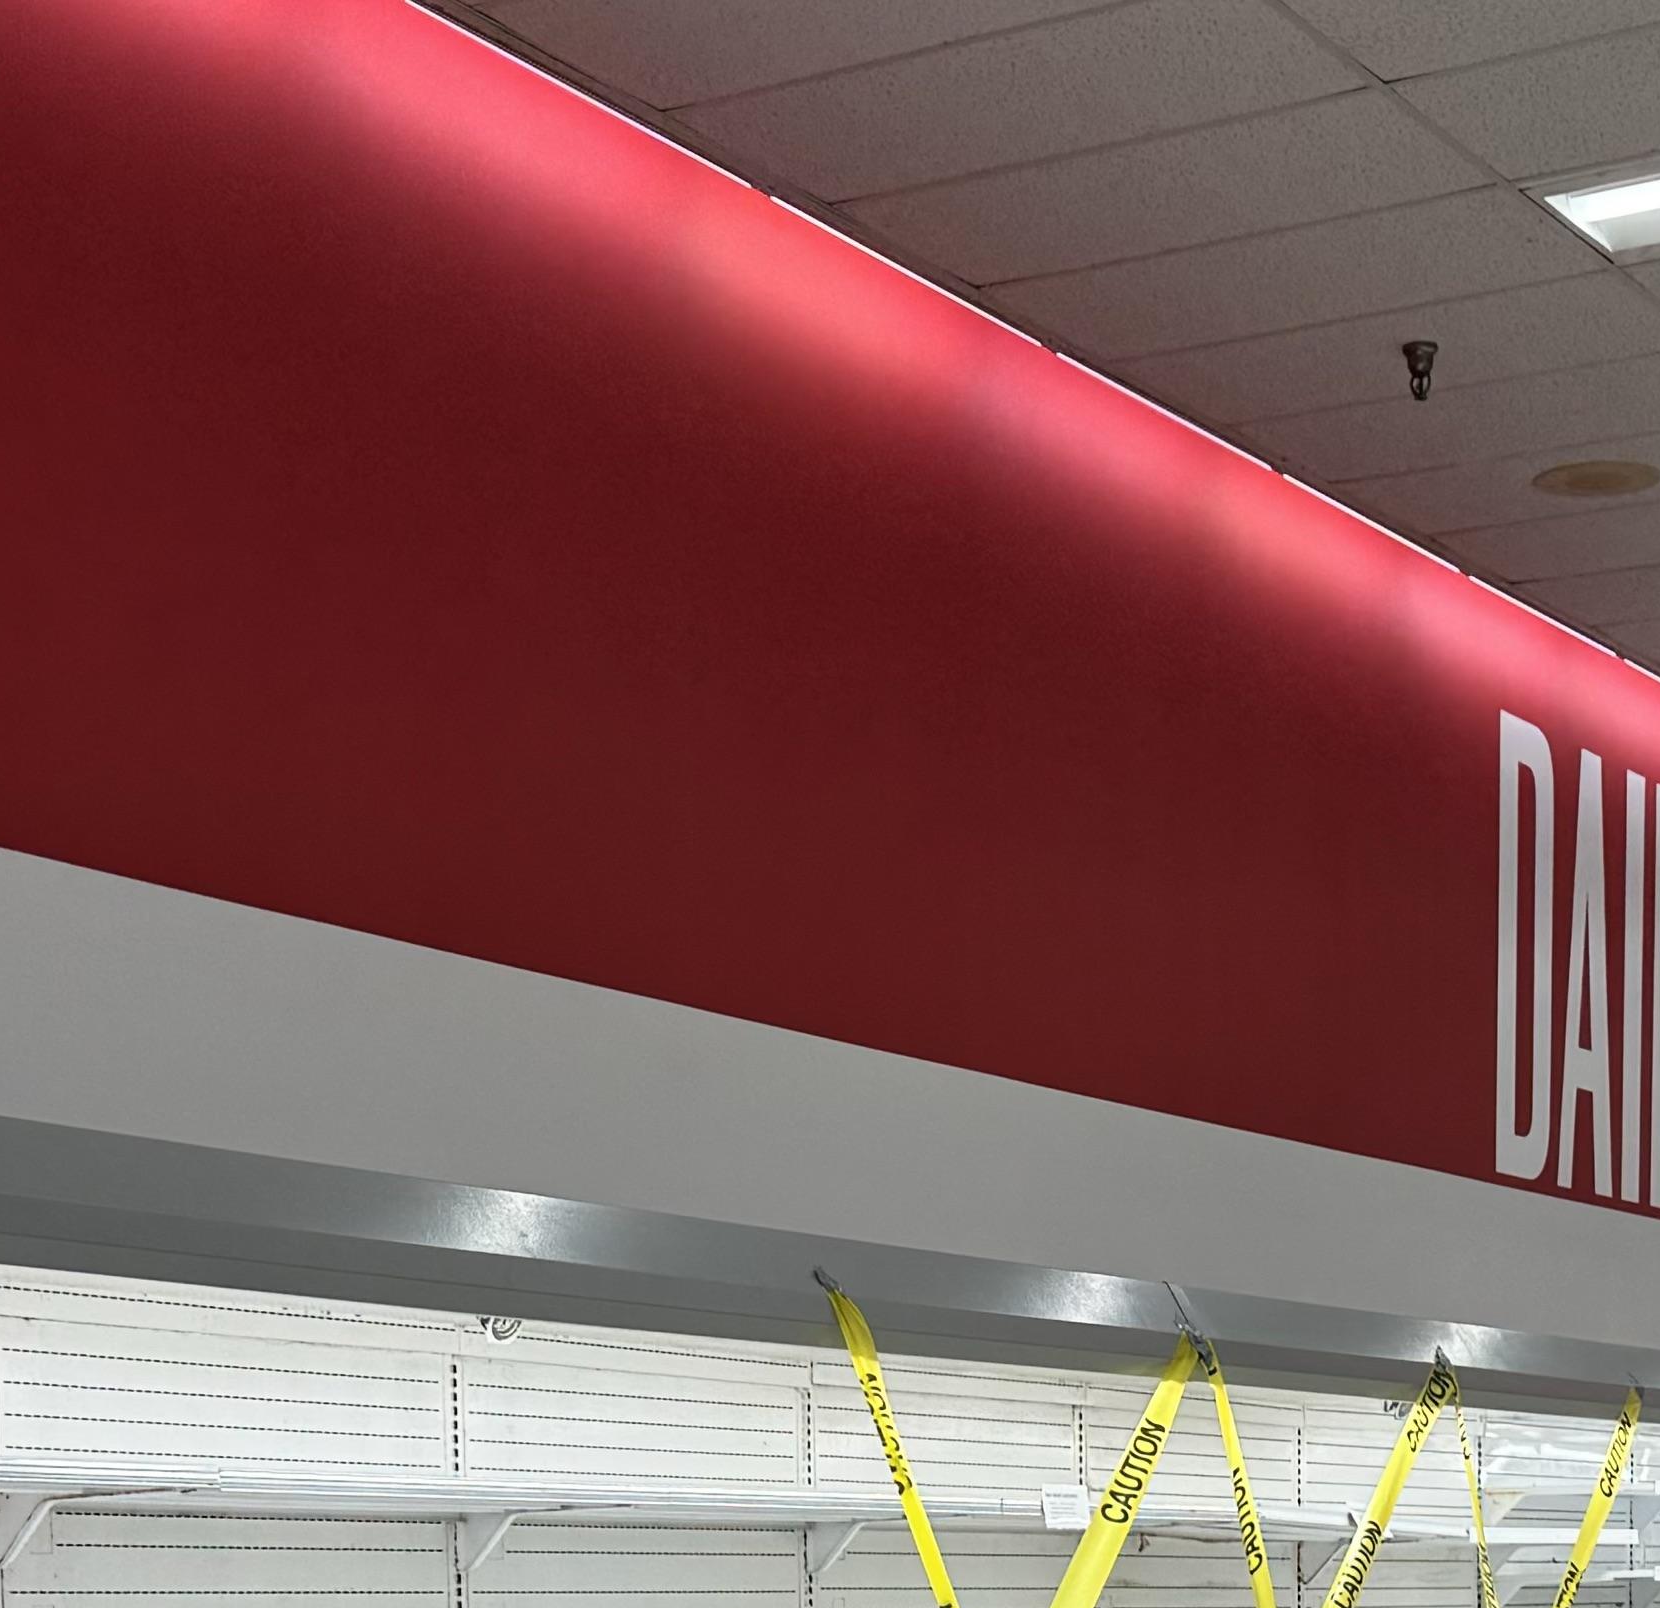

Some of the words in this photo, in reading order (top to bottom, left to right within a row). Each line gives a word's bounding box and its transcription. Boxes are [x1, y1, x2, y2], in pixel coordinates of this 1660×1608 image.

[1101, 1418, 1166, 1525] CAUTION
[1599, 1411, 1633, 1499] CAUTION
[1232, 1467, 1264, 1576] CAUTION
